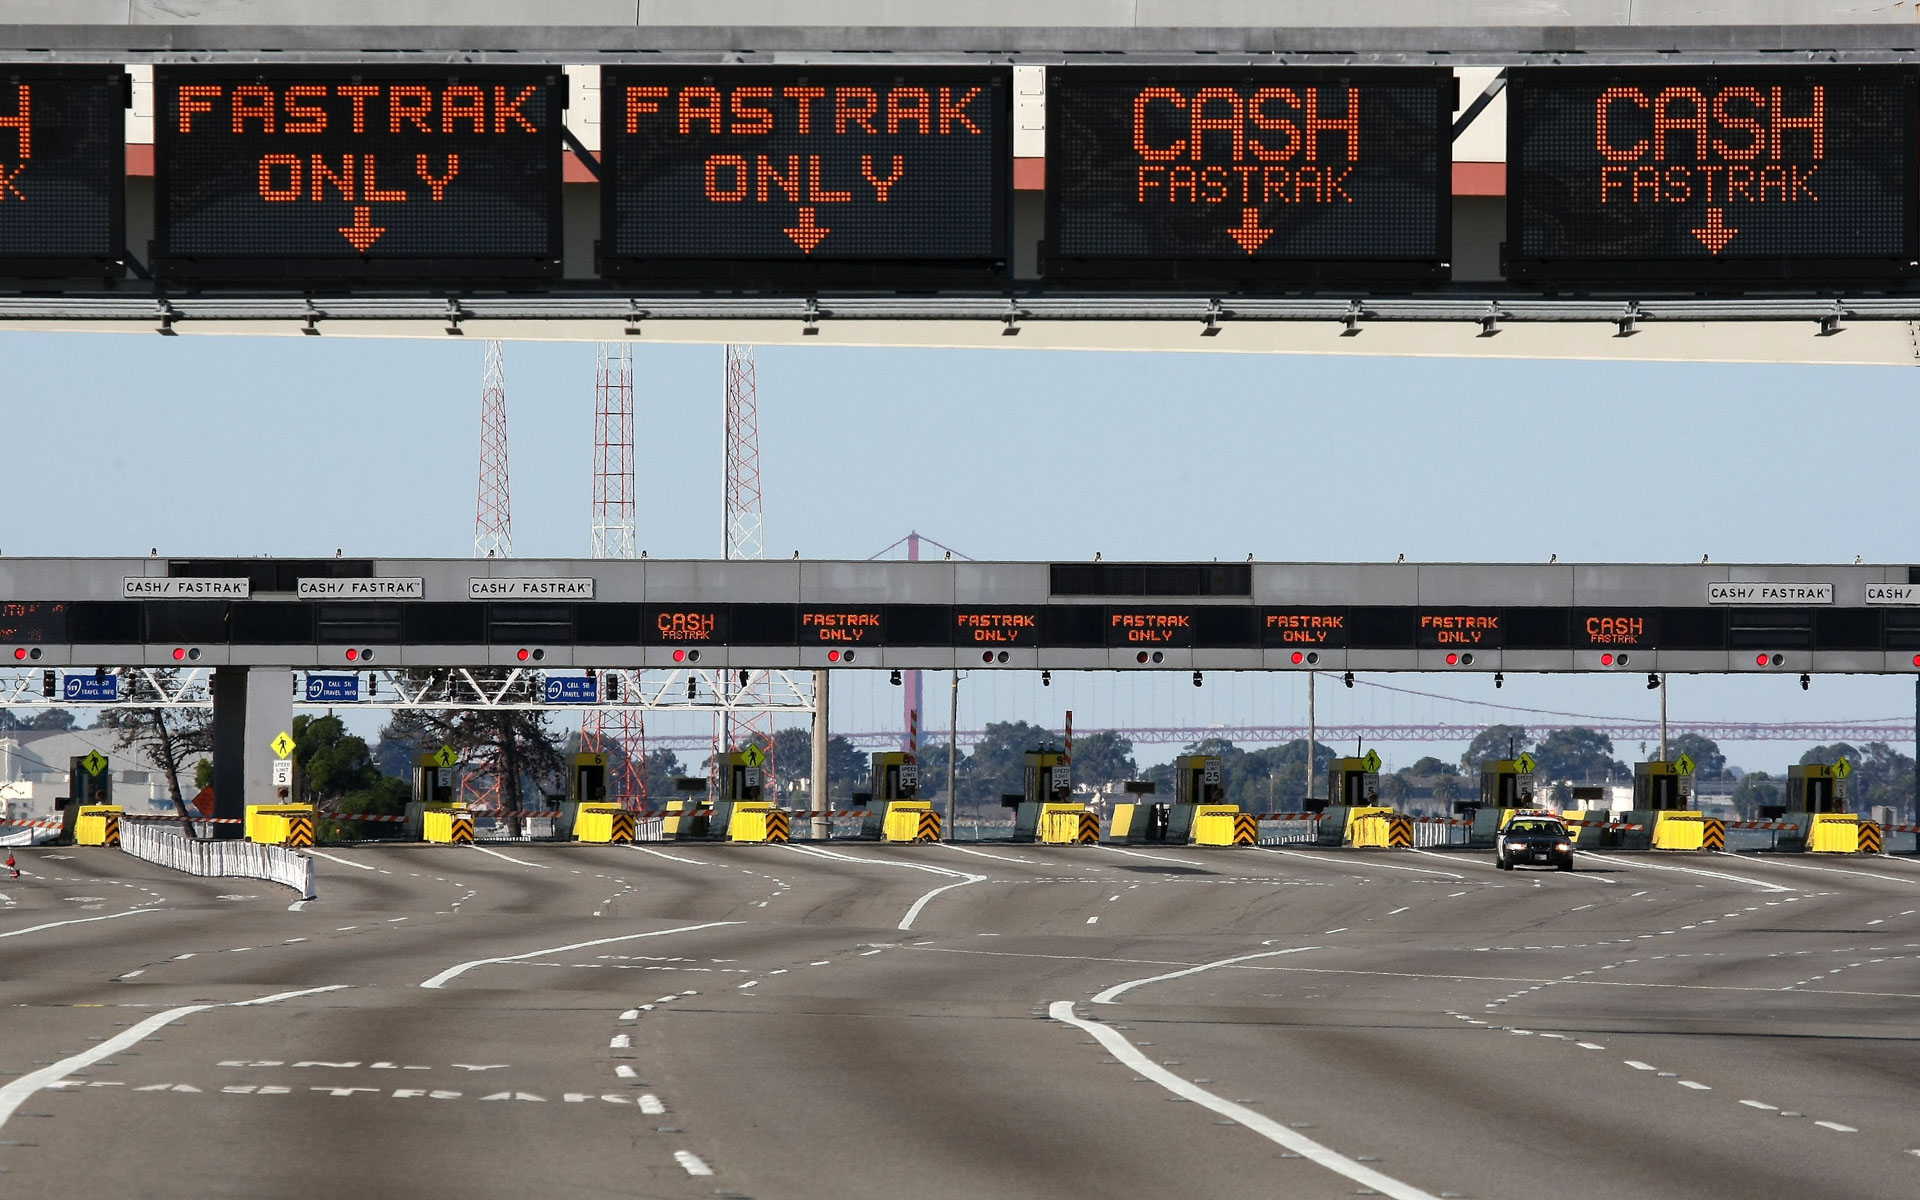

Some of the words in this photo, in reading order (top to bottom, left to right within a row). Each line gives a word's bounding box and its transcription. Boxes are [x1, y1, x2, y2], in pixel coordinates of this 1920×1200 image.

[179, 86, 537, 133] FASTRAK
[626, 86, 982, 134] FASTRAK
[1133, 87, 1359, 161] CASH
[1596, 86, 1824, 161] CASH
[259, 154, 459, 202] ONLY
[705, 154, 904, 202] ONLY
[1138, 165, 1353, 203] FASTRAK
[1601, 164, 1818, 203] FASTRAK
[126, 582, 170, 592] CASH/
[300, 583, 344, 592] CASH/
[472, 583, 515, 593] CASH/
[1711, 588, 1754, 598] CASH/
[1868, 589, 1912, 599] CASH/
[657, 613, 714, 630] CASH
[803, 613, 880, 626] FASTRAK
[958, 614, 1035, 627] FASTRAK
[1112, 614, 1189, 627] FASTRAK
[1266, 615, 1343, 628] FASTRAK
[1421, 615, 1498, 629] FASTRAK
[1586, 617, 1643, 634] CASH
[662, 630, 710, 640] FASTRAK
[819, 628, 864, 641] ONLY
[974, 629, 1018, 642] ONLY
[1128, 629, 1173, 642] ONLY
[1283, 630, 1327, 643] ONLY
[1437, 630, 1482, 643] ONLY
[1591, 634, 1637, 643] FASTRAK
[595, 754, 602, 764] 6
[1206, 772, 1220, 782] 25
[1820, 766, 1830, 776] 14
[279, 773, 286, 783] 5
[442, 777, 448, 786] 5
[749, 777, 756, 786] 5
[902, 778, 917, 788] 25
[1054, 779, 1070, 789] 25
